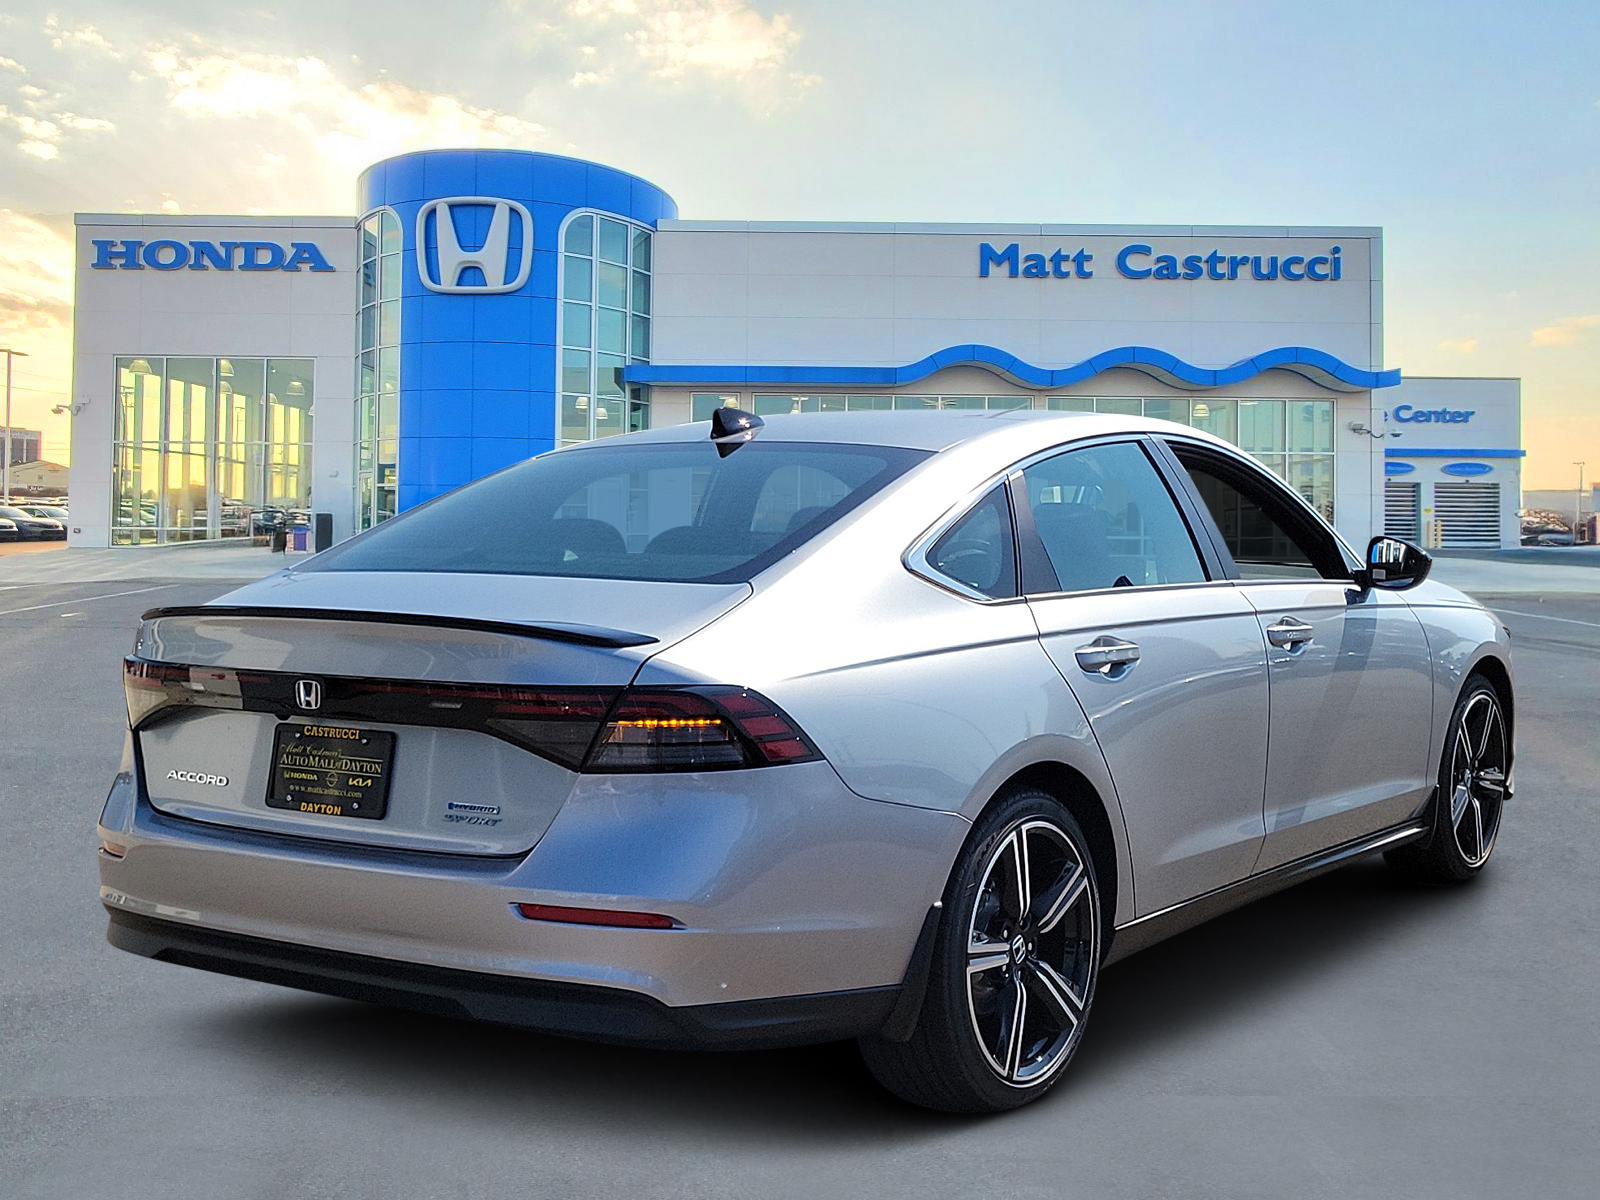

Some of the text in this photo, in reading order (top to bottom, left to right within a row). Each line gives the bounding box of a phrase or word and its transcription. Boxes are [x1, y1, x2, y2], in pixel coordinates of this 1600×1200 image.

[91, 239, 336, 272] HONDA
[979, 242, 1342, 281] Matt Castrucci
[1393, 404, 1475, 424] Center
[303, 725, 360, 740] CASTRUCCI
[166, 769, 229, 787] ACCORD
[291, 771, 318, 781] HONDA
[348, 777, 372, 787] KIA
[300, 801, 342, 816] DAYTON
[453, 803, 496, 814] HYBRID
[443, 813, 502, 827] SPORT
